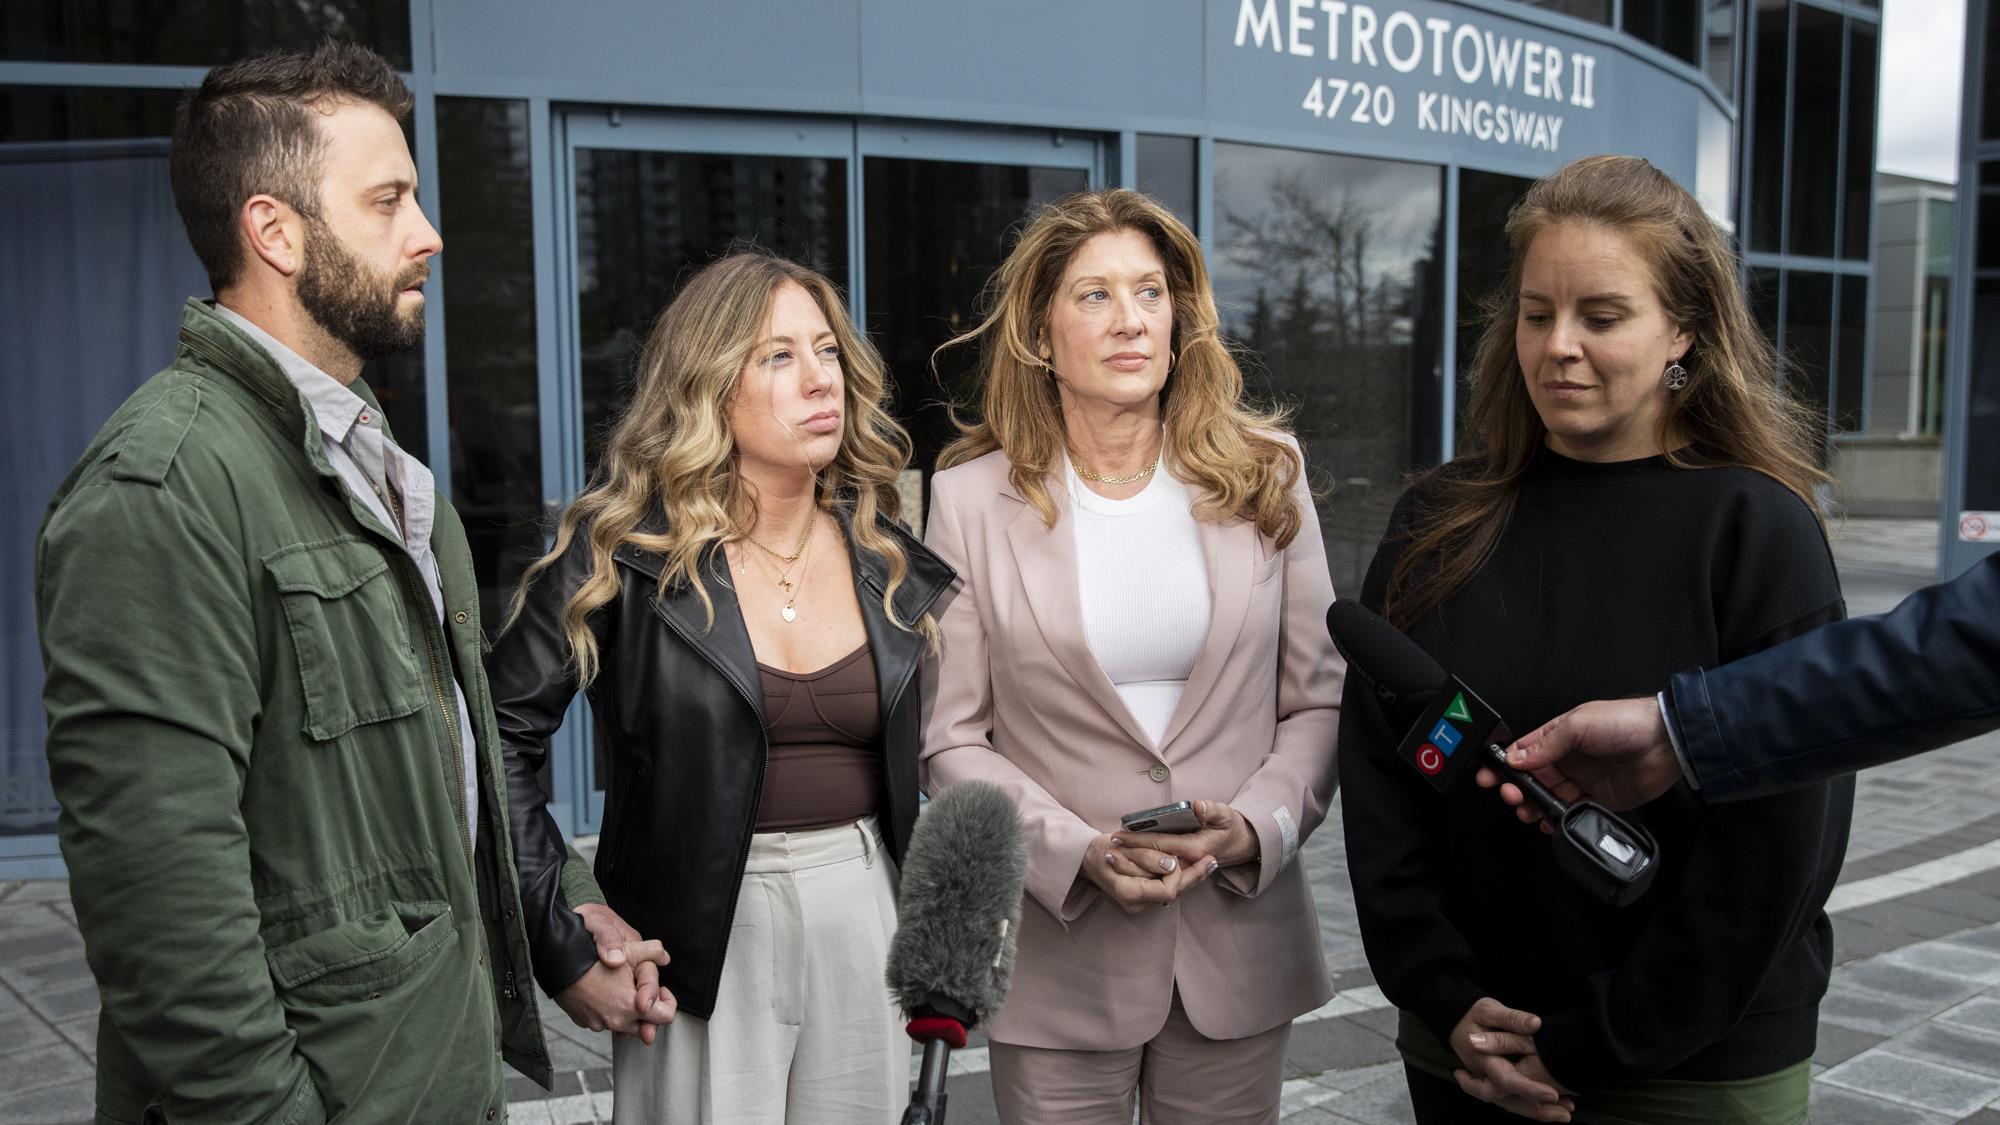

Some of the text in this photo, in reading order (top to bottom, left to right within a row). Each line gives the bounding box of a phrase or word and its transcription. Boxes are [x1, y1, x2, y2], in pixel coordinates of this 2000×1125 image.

[1234, 0, 1596, 109] METROTOWER II
[1302, 77, 1563, 152] 4720 KINGSWAY
[1418, 697, 1470, 772] CTV
